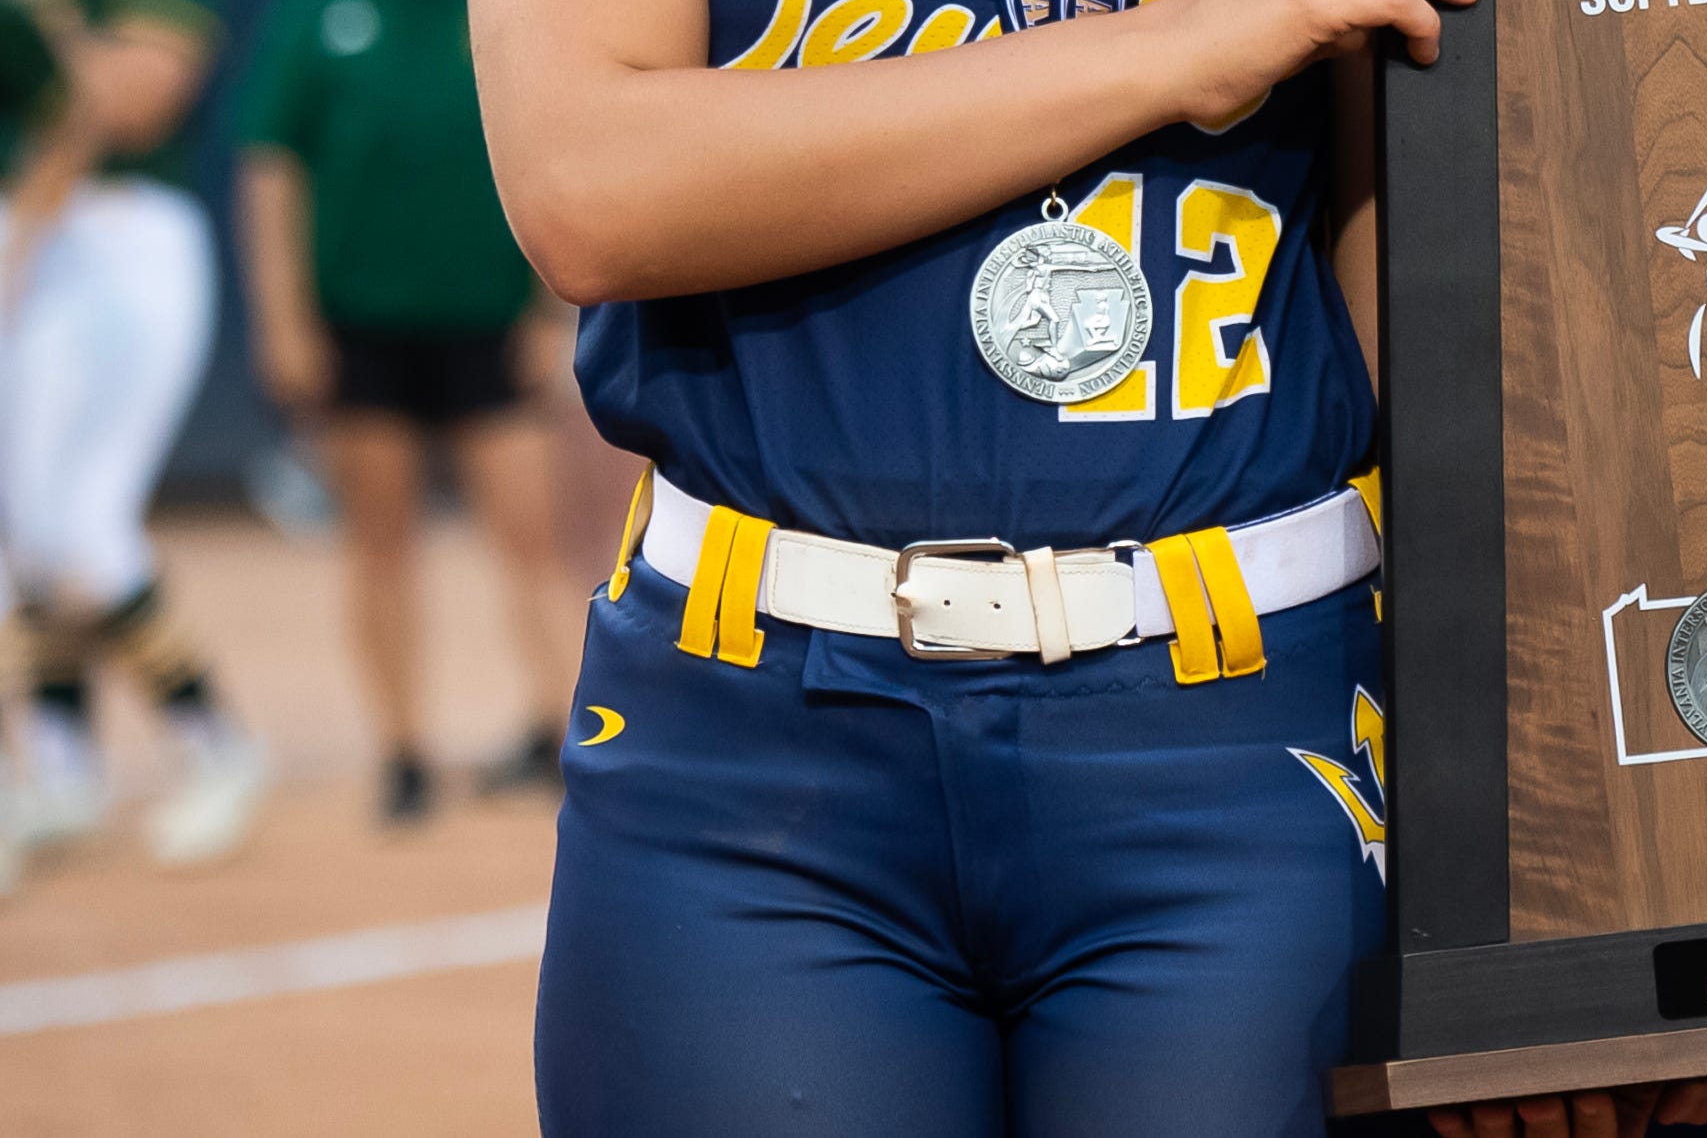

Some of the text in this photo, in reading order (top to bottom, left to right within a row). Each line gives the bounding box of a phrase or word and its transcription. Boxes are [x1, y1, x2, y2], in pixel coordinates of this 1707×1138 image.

[1059, 172, 1283, 423] 12
[1098, 231, 1149, 310] ATHLETIC
[973, 307, 1056, 399] PENNSYLVANIA
[1080, 308, 1150, 399] ASSOCIATION
